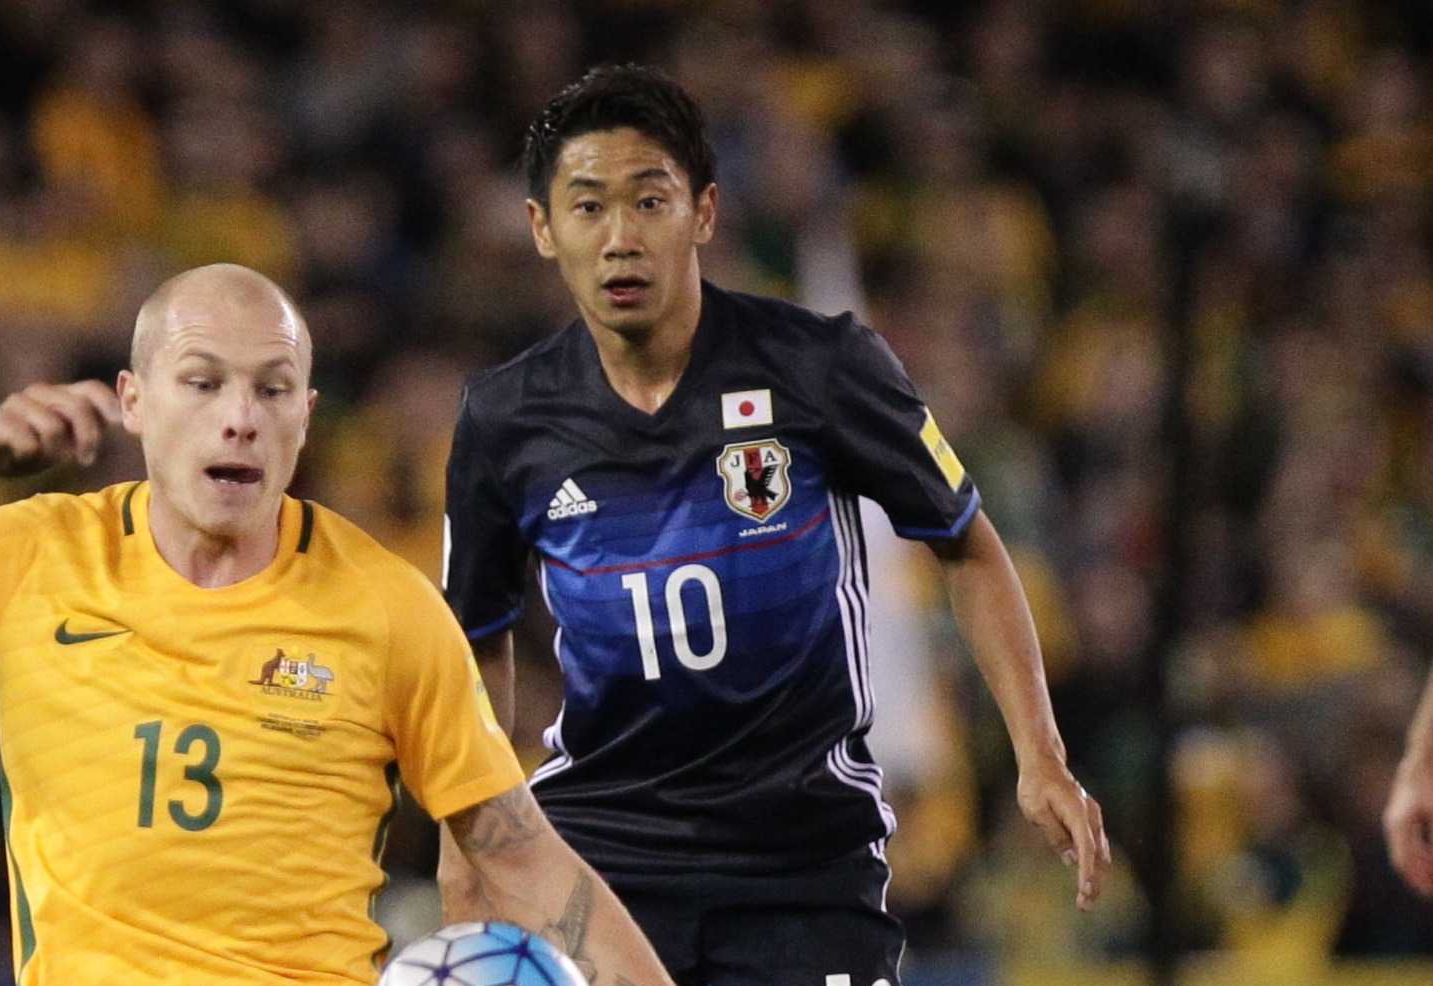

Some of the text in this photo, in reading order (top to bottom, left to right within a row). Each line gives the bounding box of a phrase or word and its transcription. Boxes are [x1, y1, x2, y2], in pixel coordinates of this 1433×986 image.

[547, 500, 598, 520] adidas
[738, 522, 787, 538] JAPAN
[621, 563, 728, 681] 10
[133, 720, 224, 832] 13
